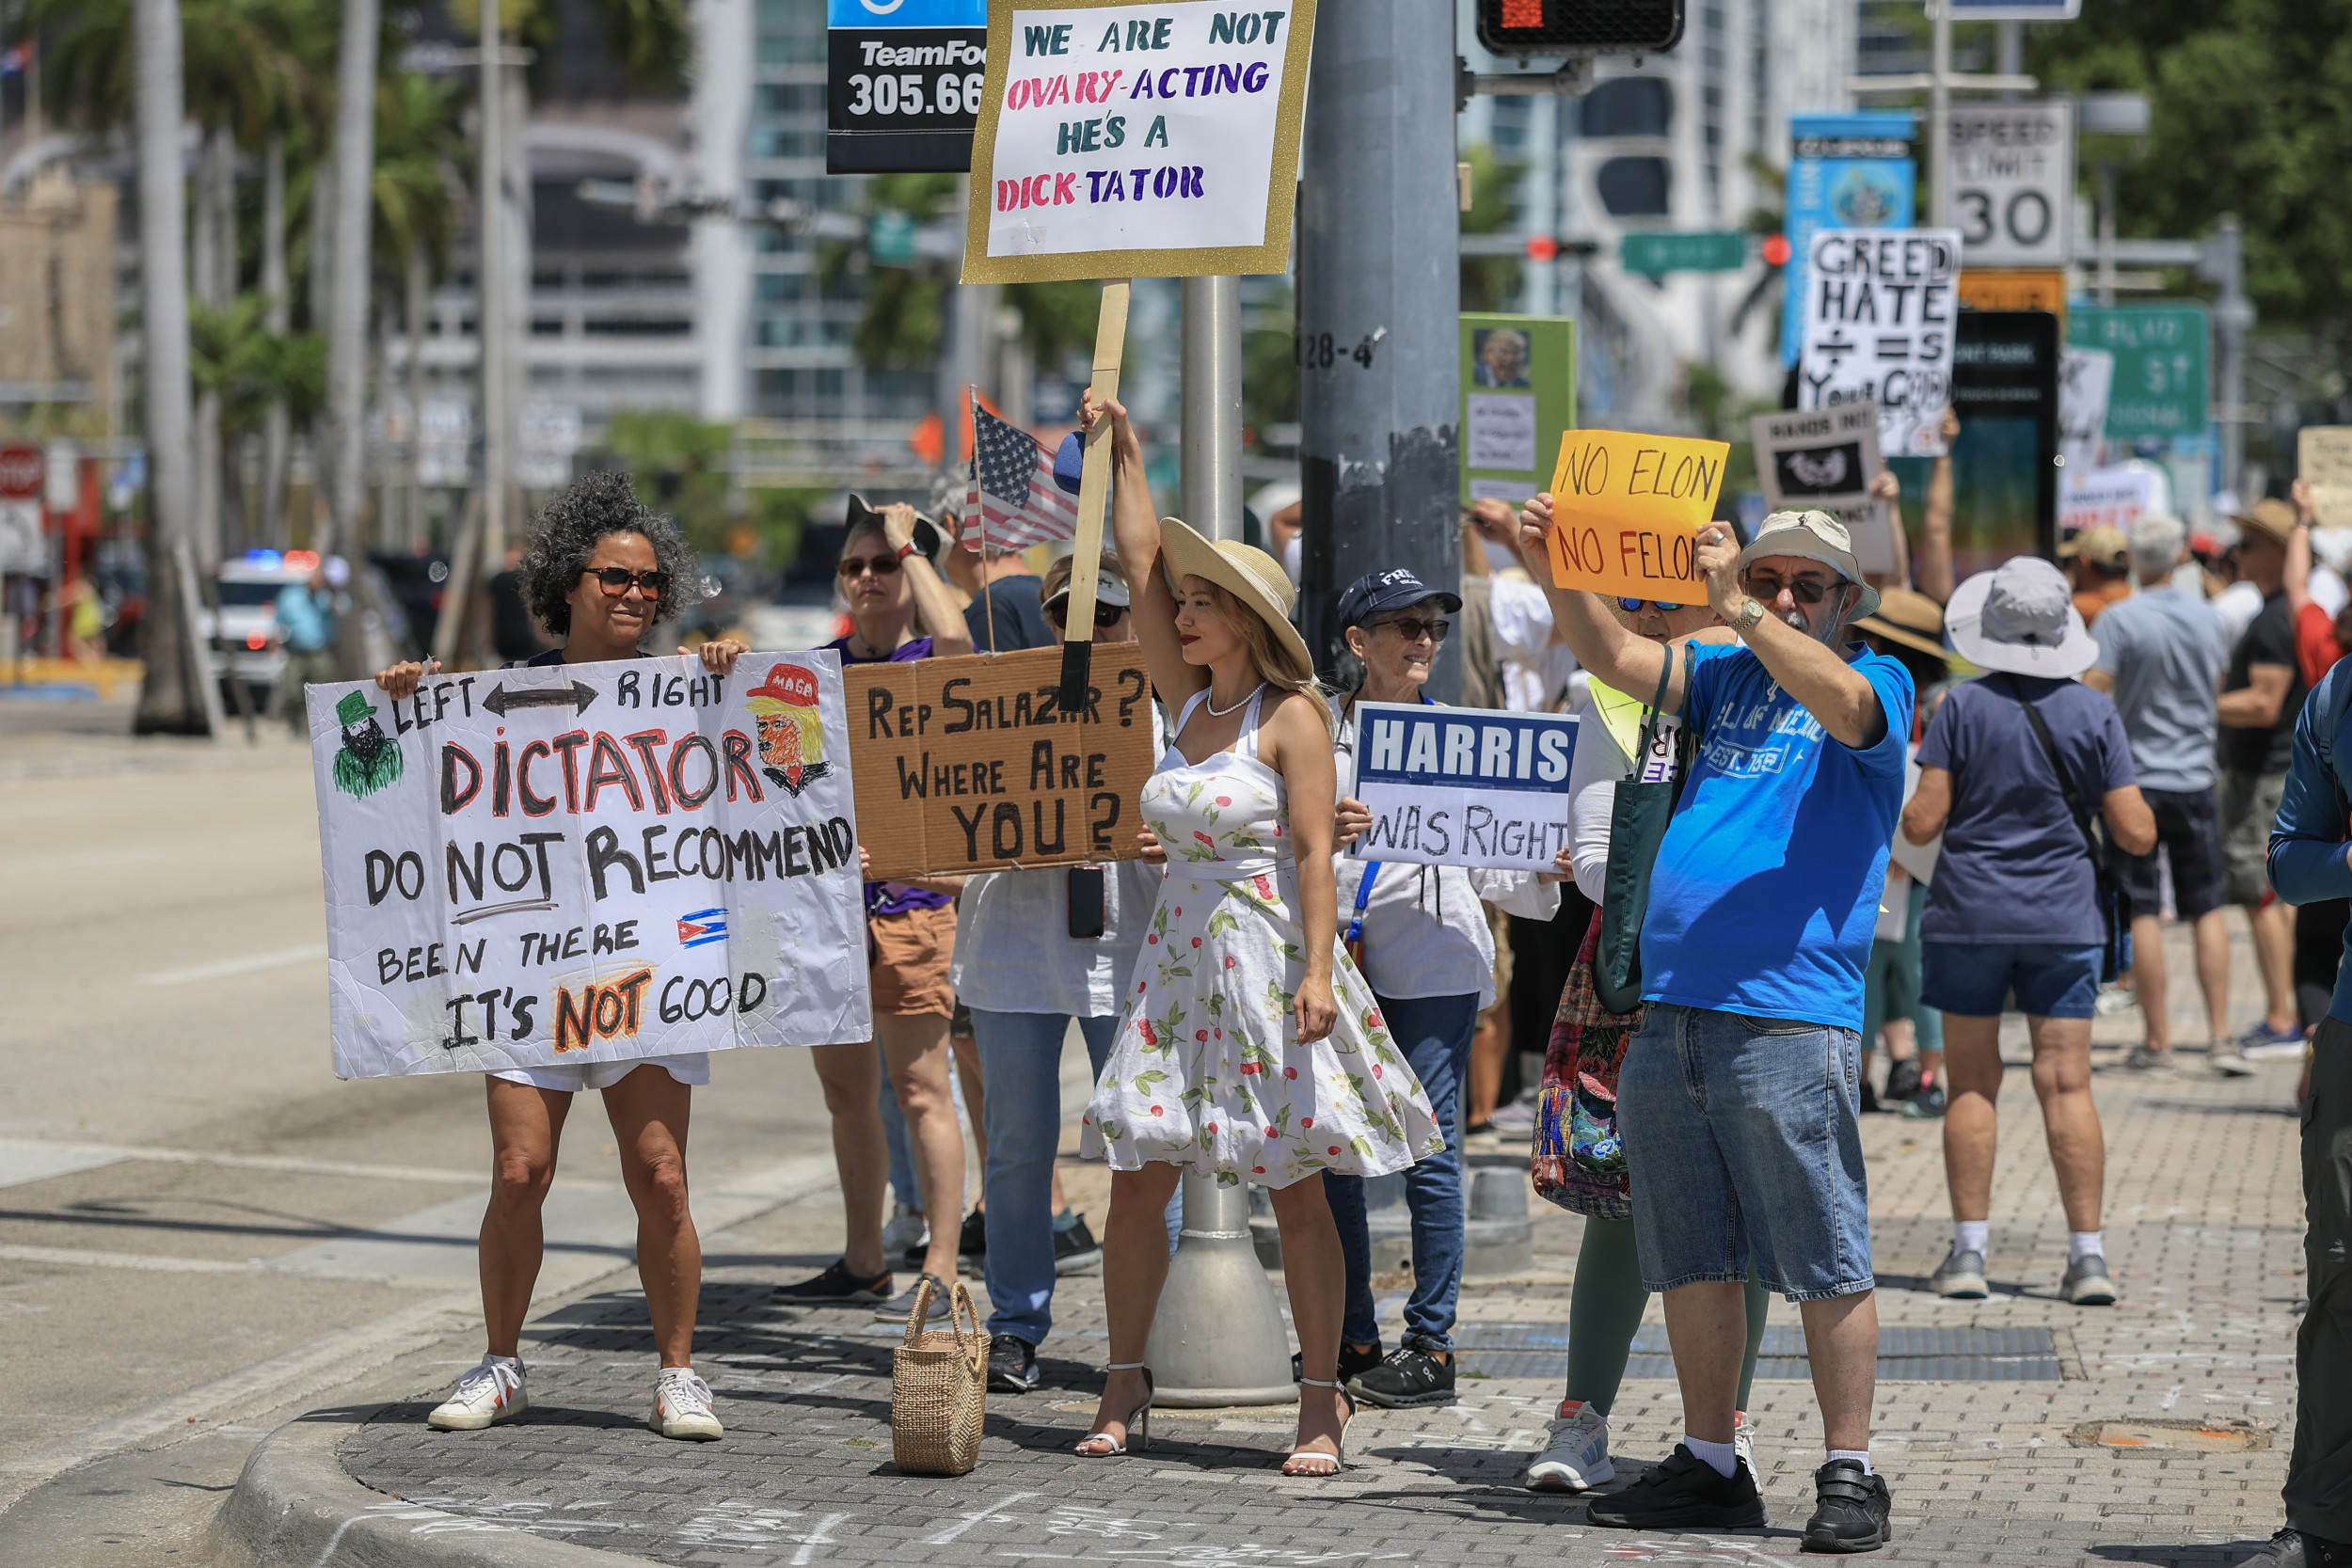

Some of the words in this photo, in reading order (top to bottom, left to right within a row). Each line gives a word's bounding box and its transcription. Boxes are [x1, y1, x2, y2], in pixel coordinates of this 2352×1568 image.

[1025, 24, 1073, 56] WE
[1097, 18, 1173, 53] ARE
[1209, 11, 1285, 44] NOT
[848, 72, 984, 115] 305.66
[1007, 61, 1270, 111] OVARY-ACTING
[1057, 109, 1126, 155] HE'S
[1144, 115, 1169, 148] A
[997, 166, 1205, 212] DICK-TATOR
[1956, 189, 2053, 246] 30
[1817, 237, 1958, 278] GREED
[1821, 280, 1948, 323] HATE
[1560, 443, 1609, 495] NO
[1629, 449, 1717, 501] ELON
[1557, 526, 1604, 575] NO
[391, 676, 475, 736] LEFT
[618, 670, 724, 708] RIGHT
[772, 674, 813, 698] MAGA
[1030, 739, 1106, 791] ARE
[1371, 720, 1568, 782] HARRIS
[1365, 803, 1450, 857] WAS
[365, 848, 424, 906] DO
[446, 832, 566, 905] NOT
[378, 937, 487, 986] BEEN
[520, 919, 640, 968] THERE
[442, 986, 538, 1050] IT'S
[554, 968, 653, 1053] NOT
[660, 971, 768, 1024] GOOD
